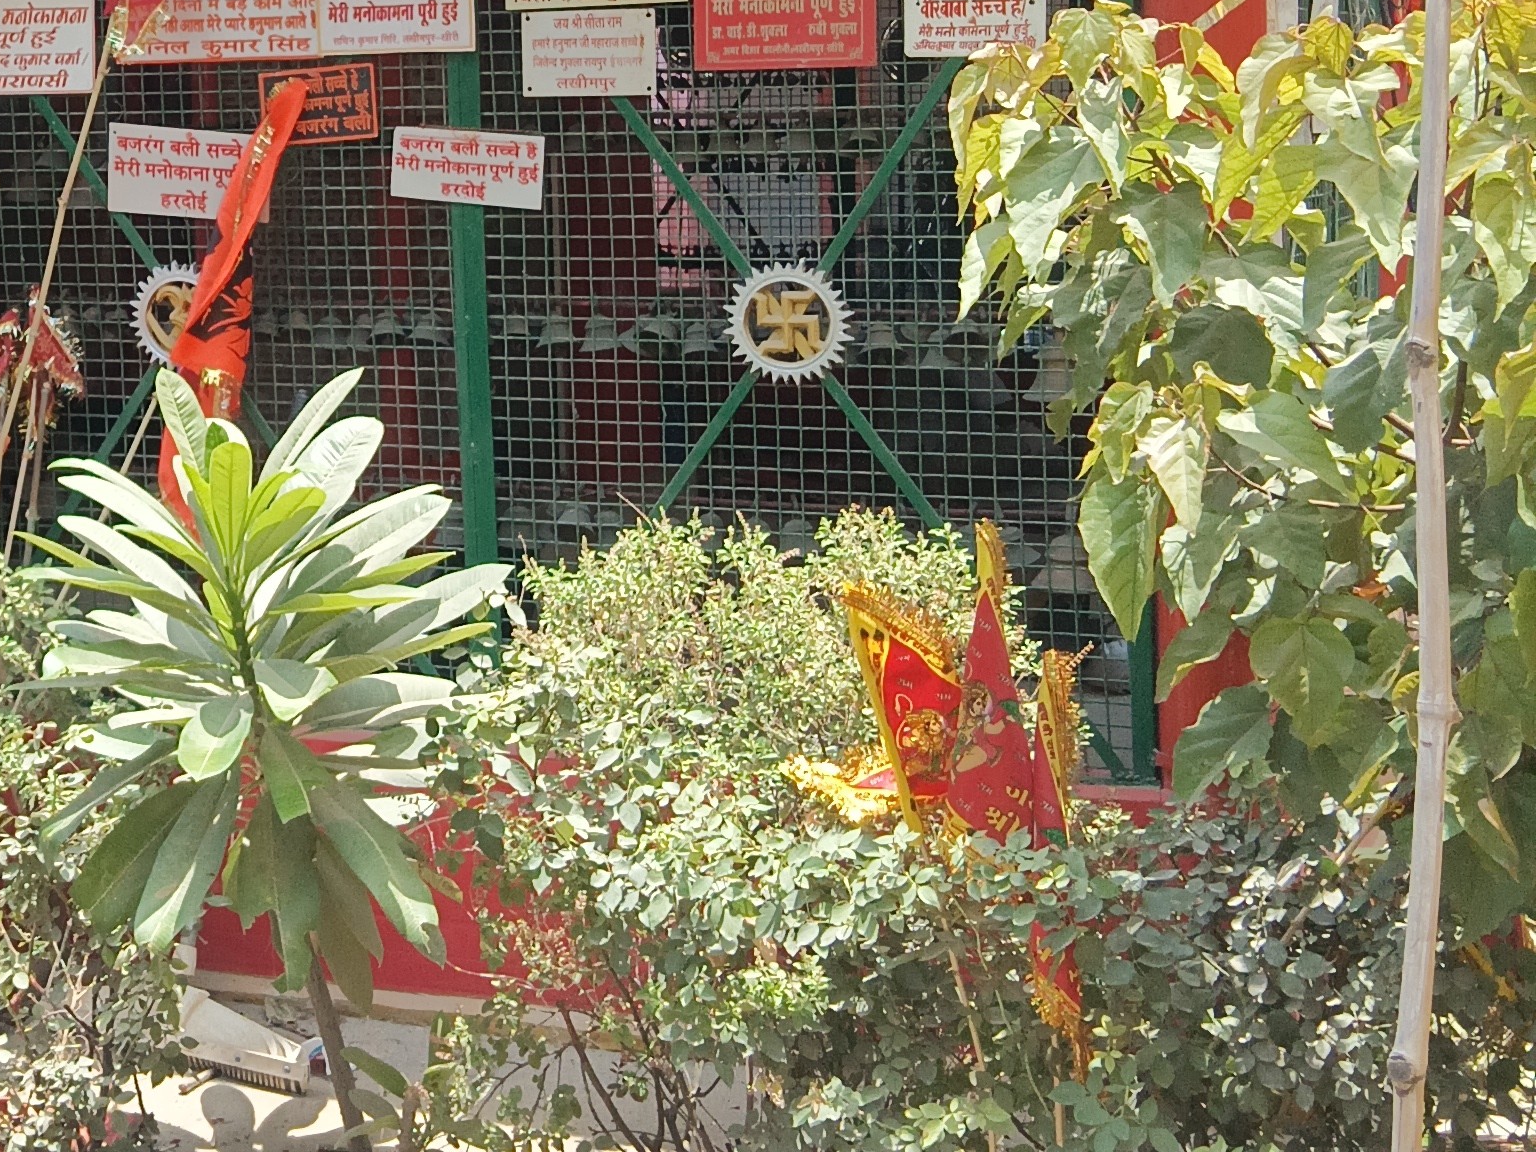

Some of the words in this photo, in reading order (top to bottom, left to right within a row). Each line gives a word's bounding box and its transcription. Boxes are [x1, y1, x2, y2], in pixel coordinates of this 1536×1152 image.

[1, 1, 89, 25] मनोकामना
[328, 1, 349, 23] मेरी
[352, 0, 413, 23] मनोकामना
[553, 18, 569, 29] जय
[572, 14, 582, 28] श्री
[584, 13, 604, 28] सीता
[606, 16, 622, 28] राम
[225, 12, 247, 31] प्यारे
[249, 15, 282, 36] हनुमान
[919, 23, 933, 37] मेरी
[995, 20, 1009, 38] पूर्ण
[1014, 19, 1030, 39] हुई
[31, 26, 60, 49] हुई
[201, 38, 262, 58] कुमार
[268, 34, 311, 52] सिंह
[14, 53, 52, 71] कुमार
[556, 73, 617, 93] लखीमपुर
[296, 117, 339, 135] बजरंग
[344, 110, 371, 132] बली
[117, 134, 164, 155] बजरंग
[170, 135, 199, 157] बली
[206, 139, 241, 159] सच्चे
[400, 137, 444, 153] बजरंग
[450, 138, 479, 156] बली
[485, 140, 521, 158] सच्चे
[115, 156, 140, 177] मेरी
[145, 159, 210, 182] मनोकाना
[395, 152, 420, 171] मेरी
[424, 156, 487, 177] मनोकाना
[490, 161, 514, 183] पूर्ण
[517, 163, 539, 185] हुई
[441, 179, 487, 200] हरदोई
[161, 190, 207, 213] हरदोई
